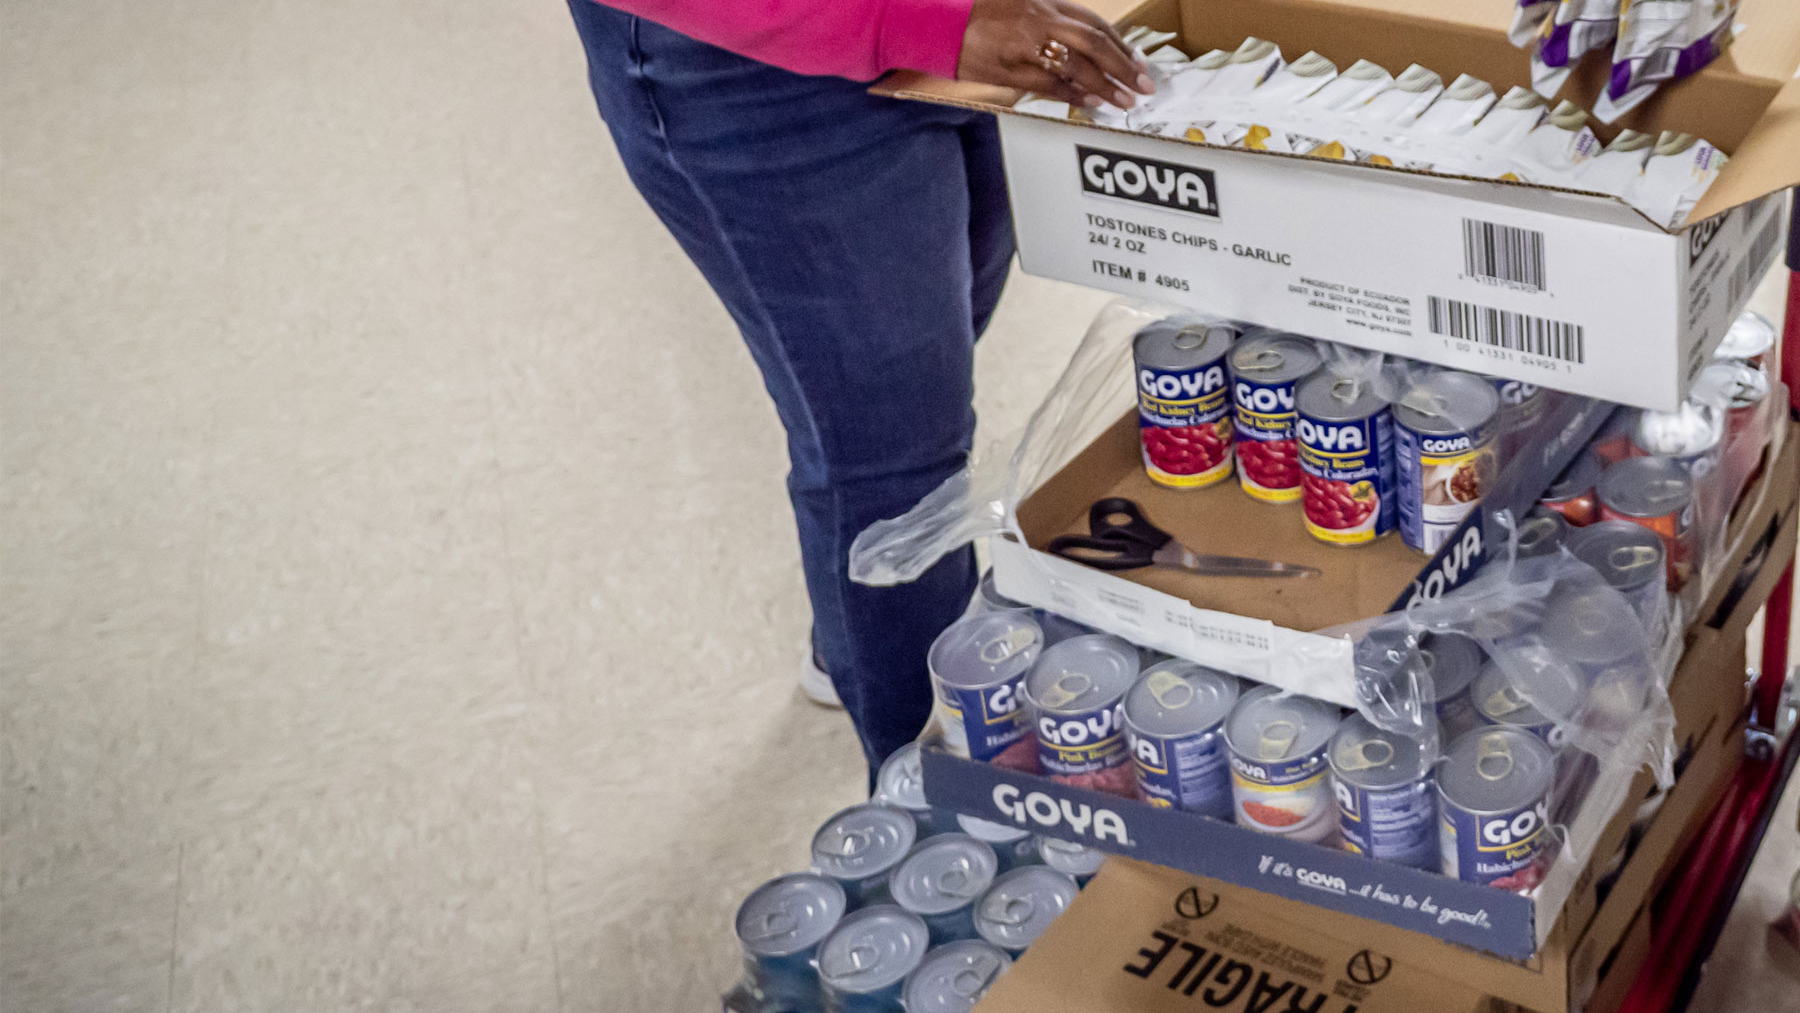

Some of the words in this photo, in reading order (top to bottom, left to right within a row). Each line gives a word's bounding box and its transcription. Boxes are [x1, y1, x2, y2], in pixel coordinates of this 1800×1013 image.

[1083, 153, 1209, 210] GOYA
[1086, 213, 1167, 241] TOSTONES
[1171, 230, 1218, 252] CHIPS
[1232, 243, 1292, 267] GARLIC
[1092, 259, 1133, 281] ITEM
[1155, 274, 1190, 292] 4905
[1140, 366, 1224, 399] GOYA
[1300, 419, 1363, 449] OYA
[1423, 436, 1472, 453] GOYA
[992, 783, 1128, 846] GOYA
[1296, 868, 1346, 892] GOYA
[1123, 930, 1357, 1013] RAGILE
